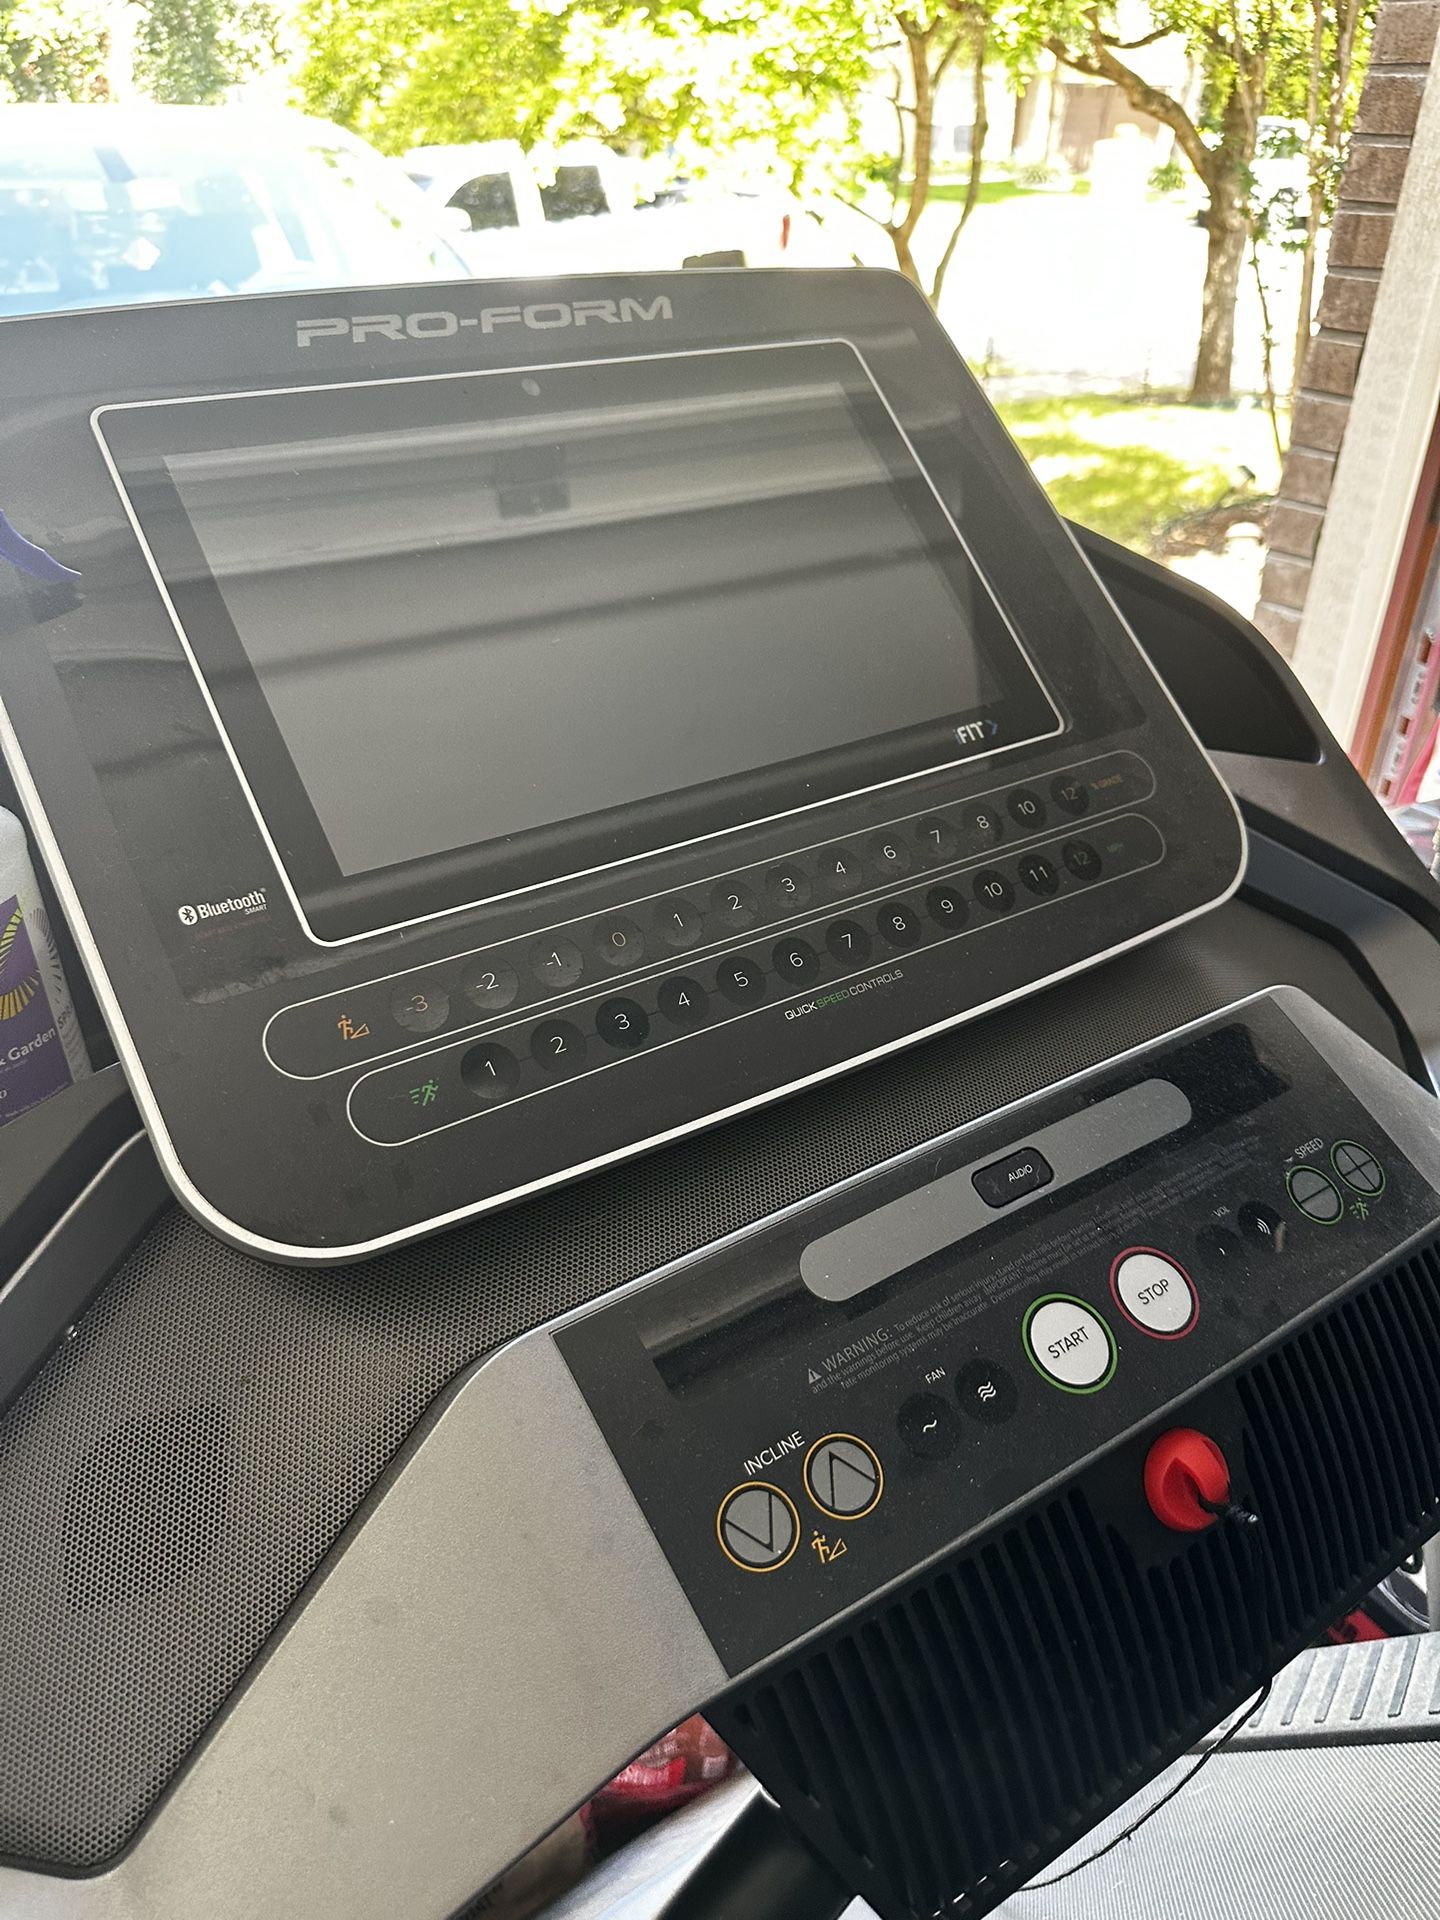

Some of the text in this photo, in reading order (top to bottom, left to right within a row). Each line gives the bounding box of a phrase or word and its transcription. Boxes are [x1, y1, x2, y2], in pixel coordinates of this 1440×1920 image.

[296, 296, 674, 347] PRO-FORM
[197, 891, 266, 919] Bluetooth
[244, 903, 267, 915] SMART
[405, 995, 428, 1012] -3
[476, 972, 499, 990] -2
[546, 951, 562, 967] -1
[611, 931, 626, 947] 0
[673, 913, 685, 927] 1
[727, 894, 743, 910] 2
[781, 877, 796, 892] 3
[835, 860, 848, 875] 4
[883, 845, 897, 859] 6
[929, 829, 940, 844] 7
[976, 815, 990, 829] 8
[1017, 800, 1037, 815] 10
[1061, 786, 1079, 801] 12
[485, 1060, 496, 1076] 1
[550, 1036, 567, 1054] 2
[614, 1013, 631, 1030] 3
[677, 991, 691, 1009] 4
[733, 971, 749, 987] 5
[789, 952, 804, 968] 6
[841, 933, 853, 949] 7
[892, 916, 906, 931] 8
[940, 899, 955, 914] 9
[983, 882, 1004, 898] 10
[1029, 865, 1049, 882] 11
[1072, 851, 1090, 866] 12
[784, 969, 904, 1020] QUICK SPEED CONTROLS
[8, 1027, 56, 1060] Garden
[1294, 1137, 1324, 1159] SPEED
[1008, 1164, 1033, 1183] AUDIO
[1212, 1205, 1231, 1218] VOL
[1137, 1278, 1169, 1305] STOP
[821, 1327, 894, 1373] WARNING:
[856, 1352, 901, 1380] monitoring
[899, 1337, 929, 1358] systems
[1047, 1326, 1090, 1359] START
[812, 1379, 829, 1395] and
[828, 1371, 842, 1388] the
[841, 1353, 877, 1378] warnings
[875, 1339, 901, 1359] before
[925, 1366, 947, 1385] FAN
[743, 1430, 806, 1476] INCLINE
